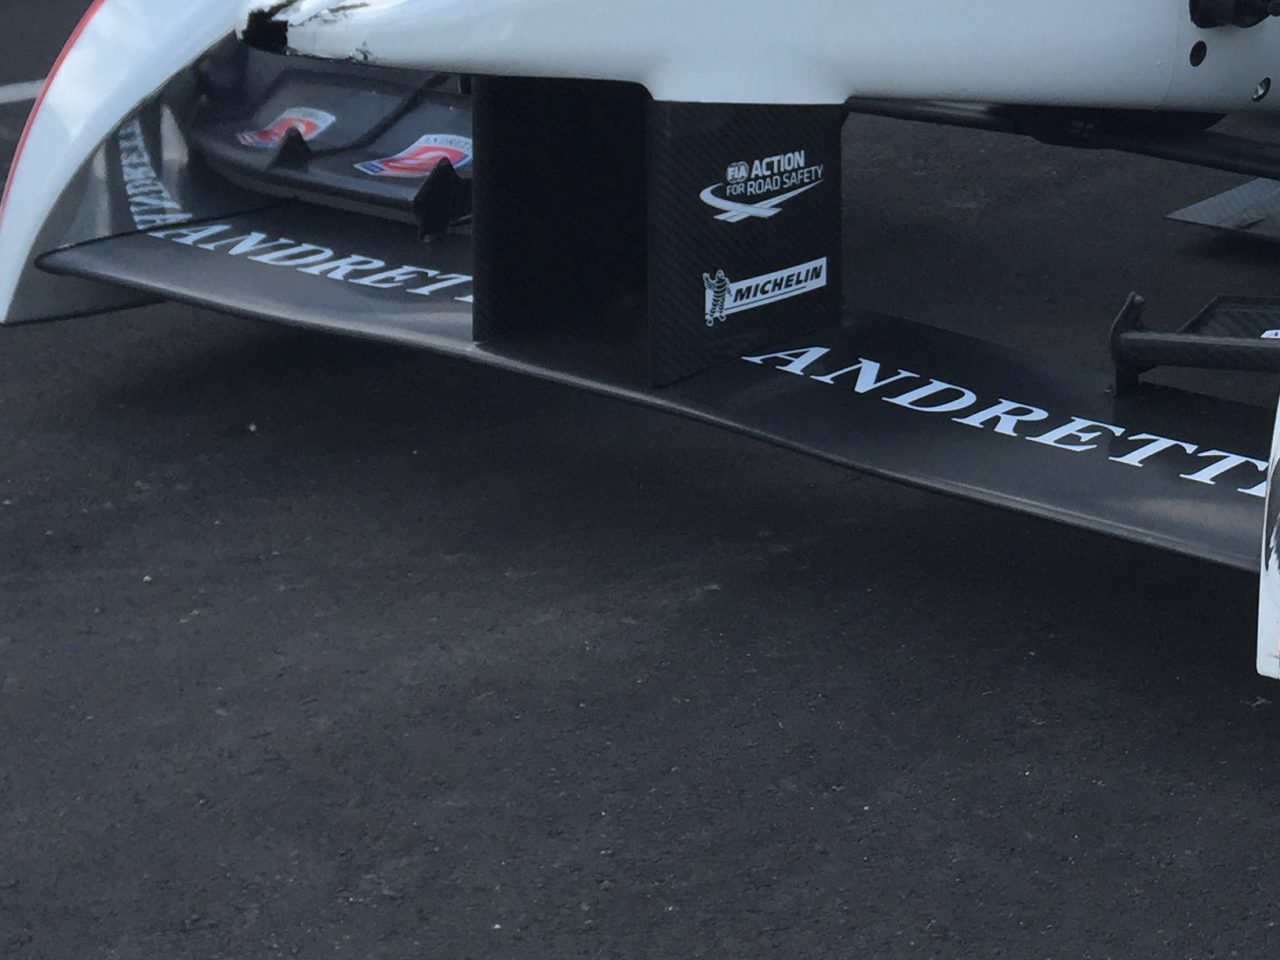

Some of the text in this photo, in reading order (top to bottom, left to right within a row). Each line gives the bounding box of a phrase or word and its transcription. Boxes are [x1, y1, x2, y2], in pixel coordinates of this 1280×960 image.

[726, 150, 805, 181] FIA ACTION
[726, 164, 824, 196] FOR ROAD SAFETY
[733, 264, 823, 303] MICHELIN
